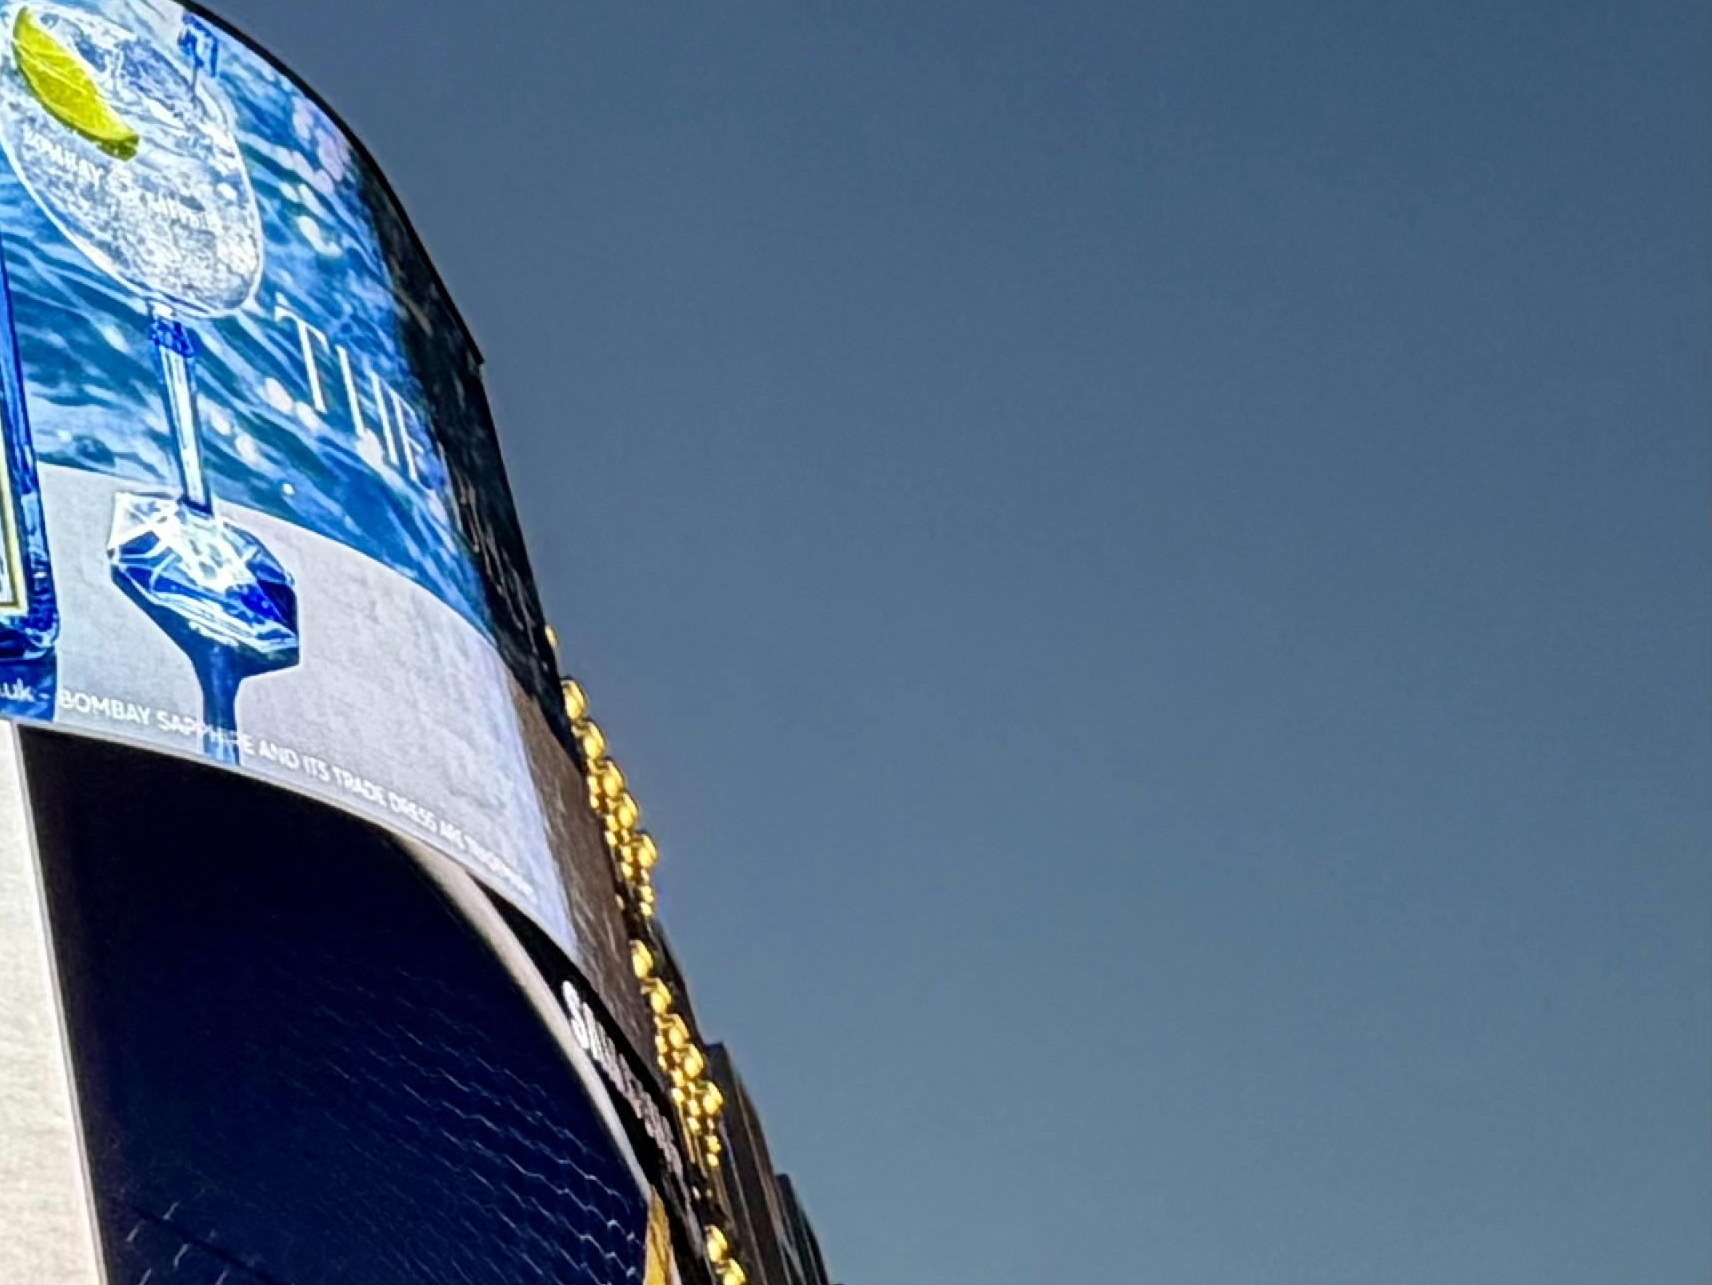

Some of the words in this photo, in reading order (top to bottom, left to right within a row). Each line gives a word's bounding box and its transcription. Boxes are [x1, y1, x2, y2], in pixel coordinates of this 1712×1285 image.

[59, 689, 151, 725] BOMBAY
[259, 739, 301, 770] AND
[302, 756, 331, 783] ITS
